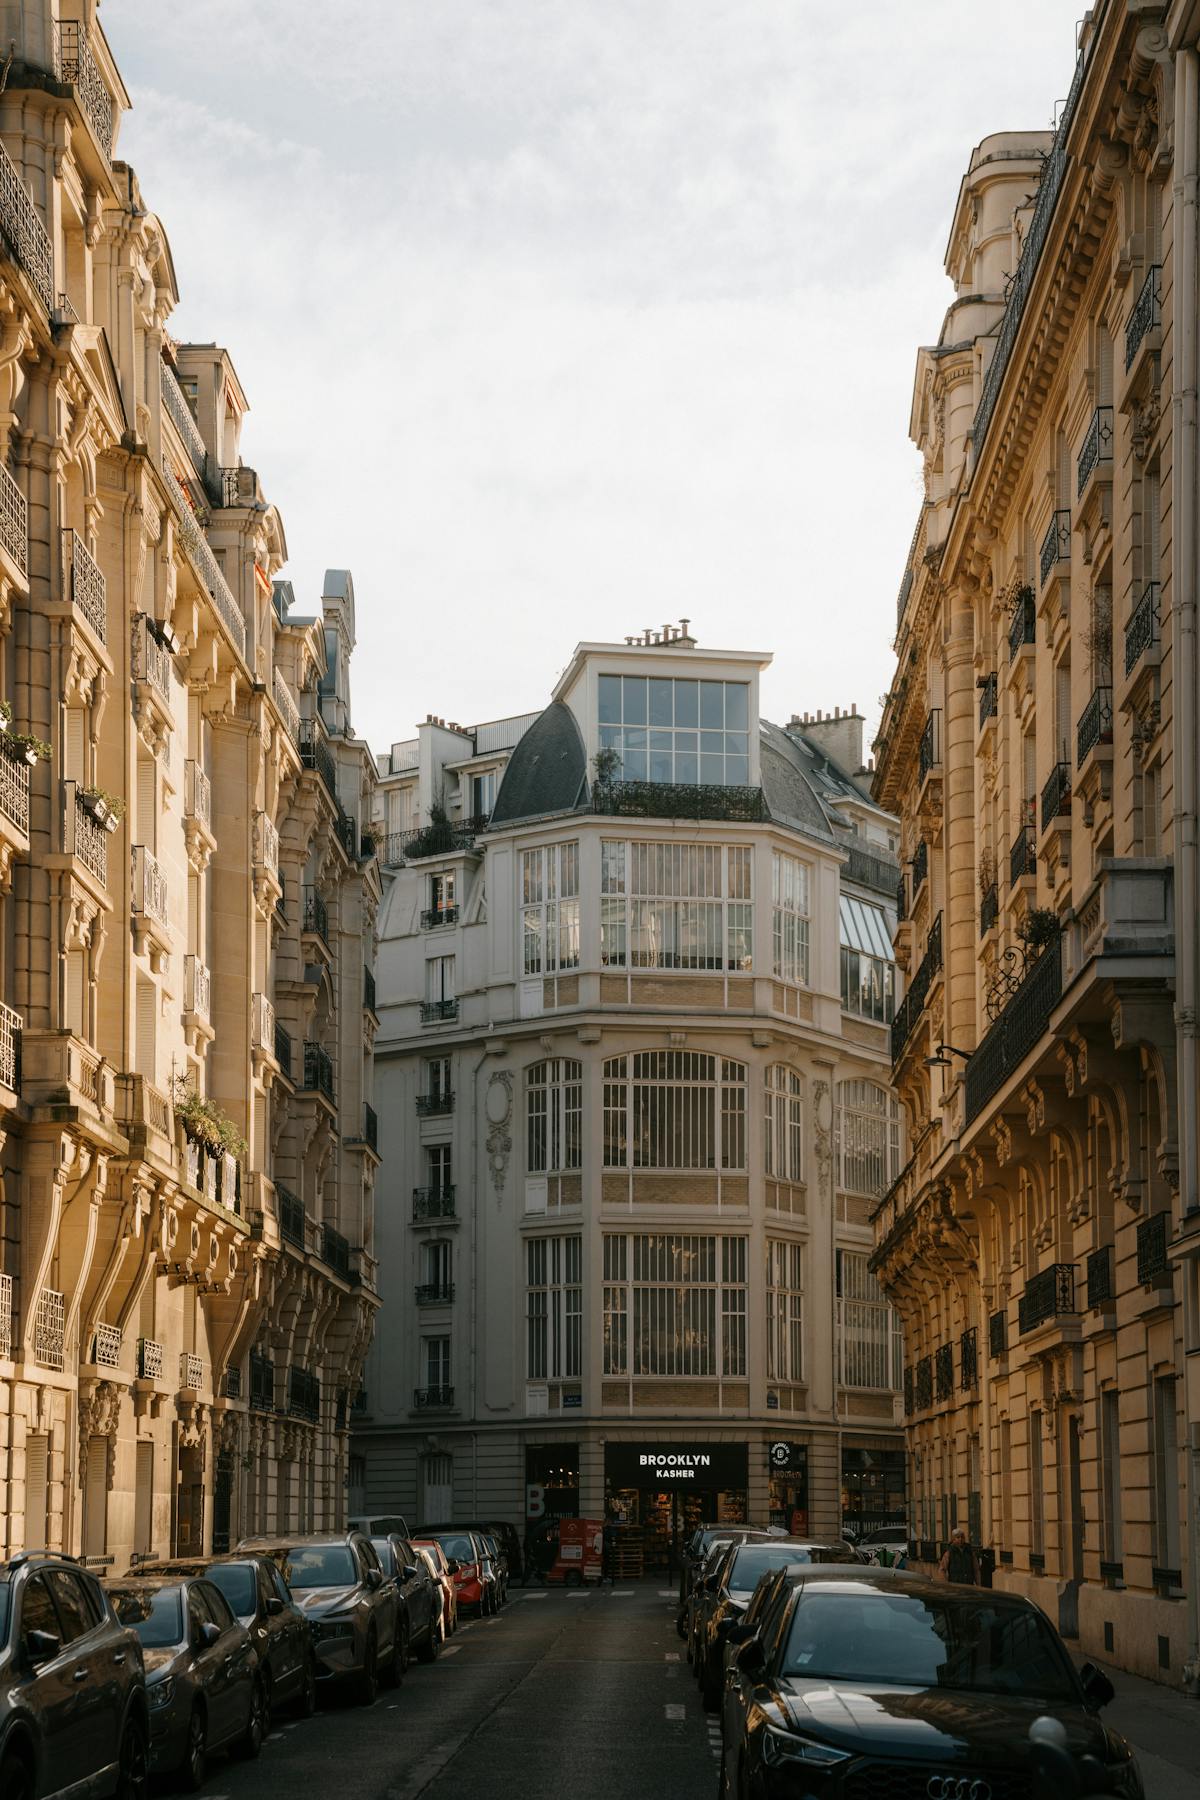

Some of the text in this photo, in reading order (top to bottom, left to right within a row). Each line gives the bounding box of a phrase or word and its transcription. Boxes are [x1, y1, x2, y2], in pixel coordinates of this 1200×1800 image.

[639, 1455, 711, 1466] BROOKLYN
[656, 1469, 695, 1478] KASHER
[527, 1484, 545, 1517] B
